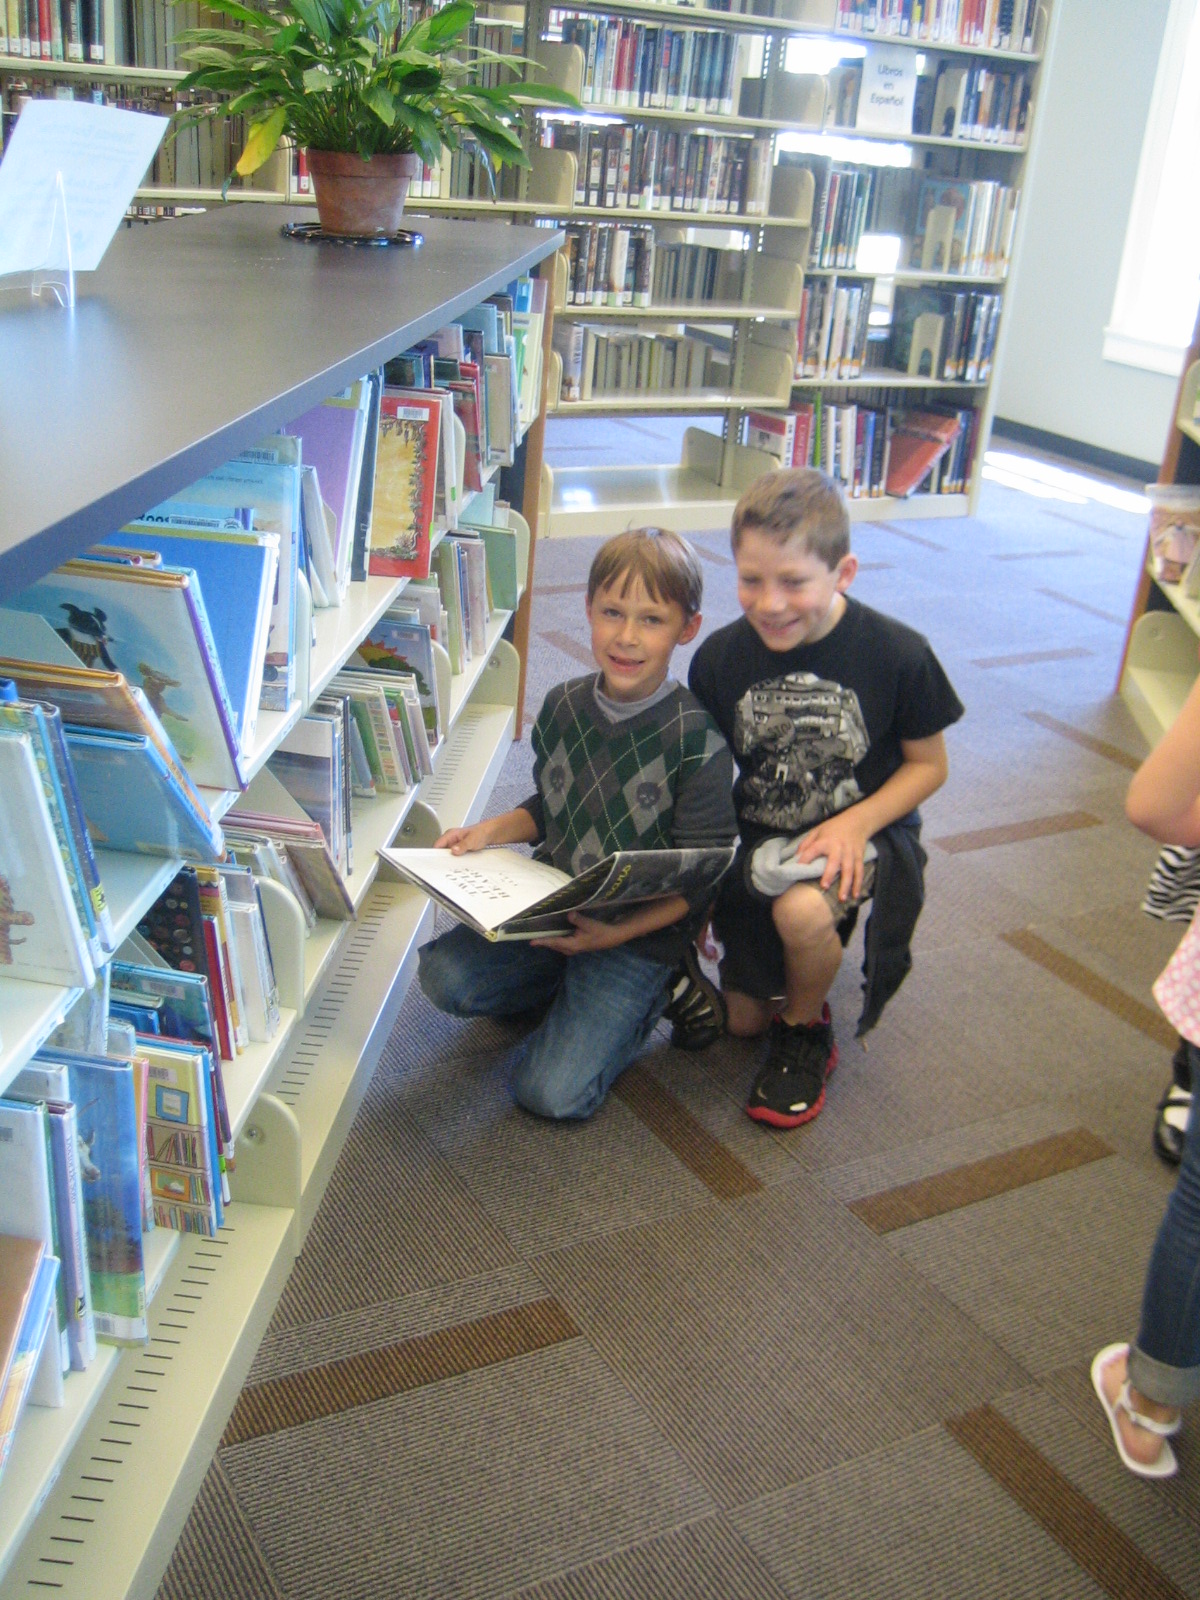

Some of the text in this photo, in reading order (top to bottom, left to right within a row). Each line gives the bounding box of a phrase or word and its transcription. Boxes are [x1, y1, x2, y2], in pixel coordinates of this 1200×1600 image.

[877, 63, 903, 77] Libros
[883, 82, 895, 90] en
[869, 93, 904, 106] Español
